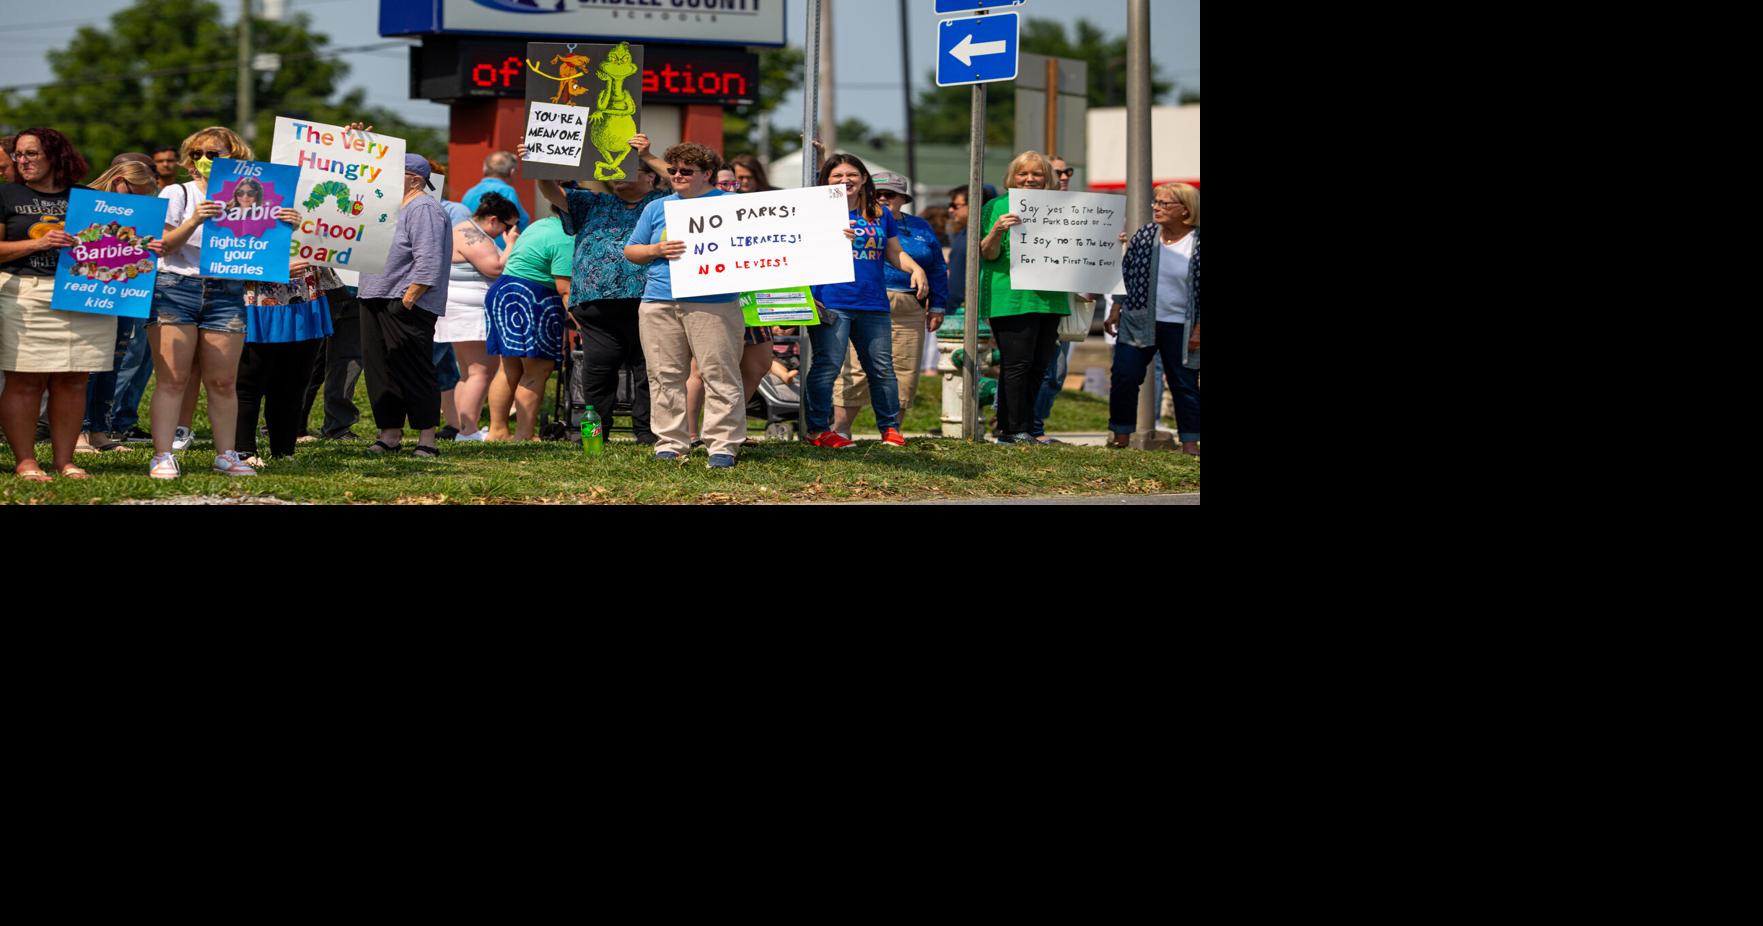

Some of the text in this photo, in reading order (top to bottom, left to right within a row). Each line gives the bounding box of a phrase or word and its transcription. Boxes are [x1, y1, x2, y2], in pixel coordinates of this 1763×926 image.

[611, 10, 718, 22] SCHOOLS
[472, 57, 524, 88] of
[534, 110, 583, 126] YOU'RE A
[292, 122, 390, 160] The Very
[528, 127, 559, 139] MEAN
[526, 142, 582, 159] MR. SAXE!
[232, 159, 264, 177] This
[298, 149, 382, 184] Hungry
[94, 200, 135, 216] These
[1020, 199, 1039, 217] Say
[1071, 205, 1079, 214] To
[1082, 206, 1094, 214] The
[688, 205, 796, 234] NO PARKS!
[1042, 217, 1061, 226] Park
[1063, 218, 1088, 226] Board
[301, 217, 365, 242] chool
[209, 235, 269, 250] fights for
[694, 233, 802, 256] NO LIBRARIES!
[1020, 232, 1027, 244] I
[1033, 237, 1052, 248] say
[1075, 238, 1083, 247] To
[1086, 238, 1096, 247] The
[1099, 239, 1115, 250] Levy
[72, 244, 144, 261] Barbies
[224, 250, 256, 262] your
[1020, 254, 1036, 264] For
[1043, 256, 1060, 265] The
[1062, 256, 1082, 265] First
[209, 261, 265, 276] libraries
[698, 263, 726, 276] NO
[64, 281, 150, 299] read to your
[84, 297, 115, 309] kids
